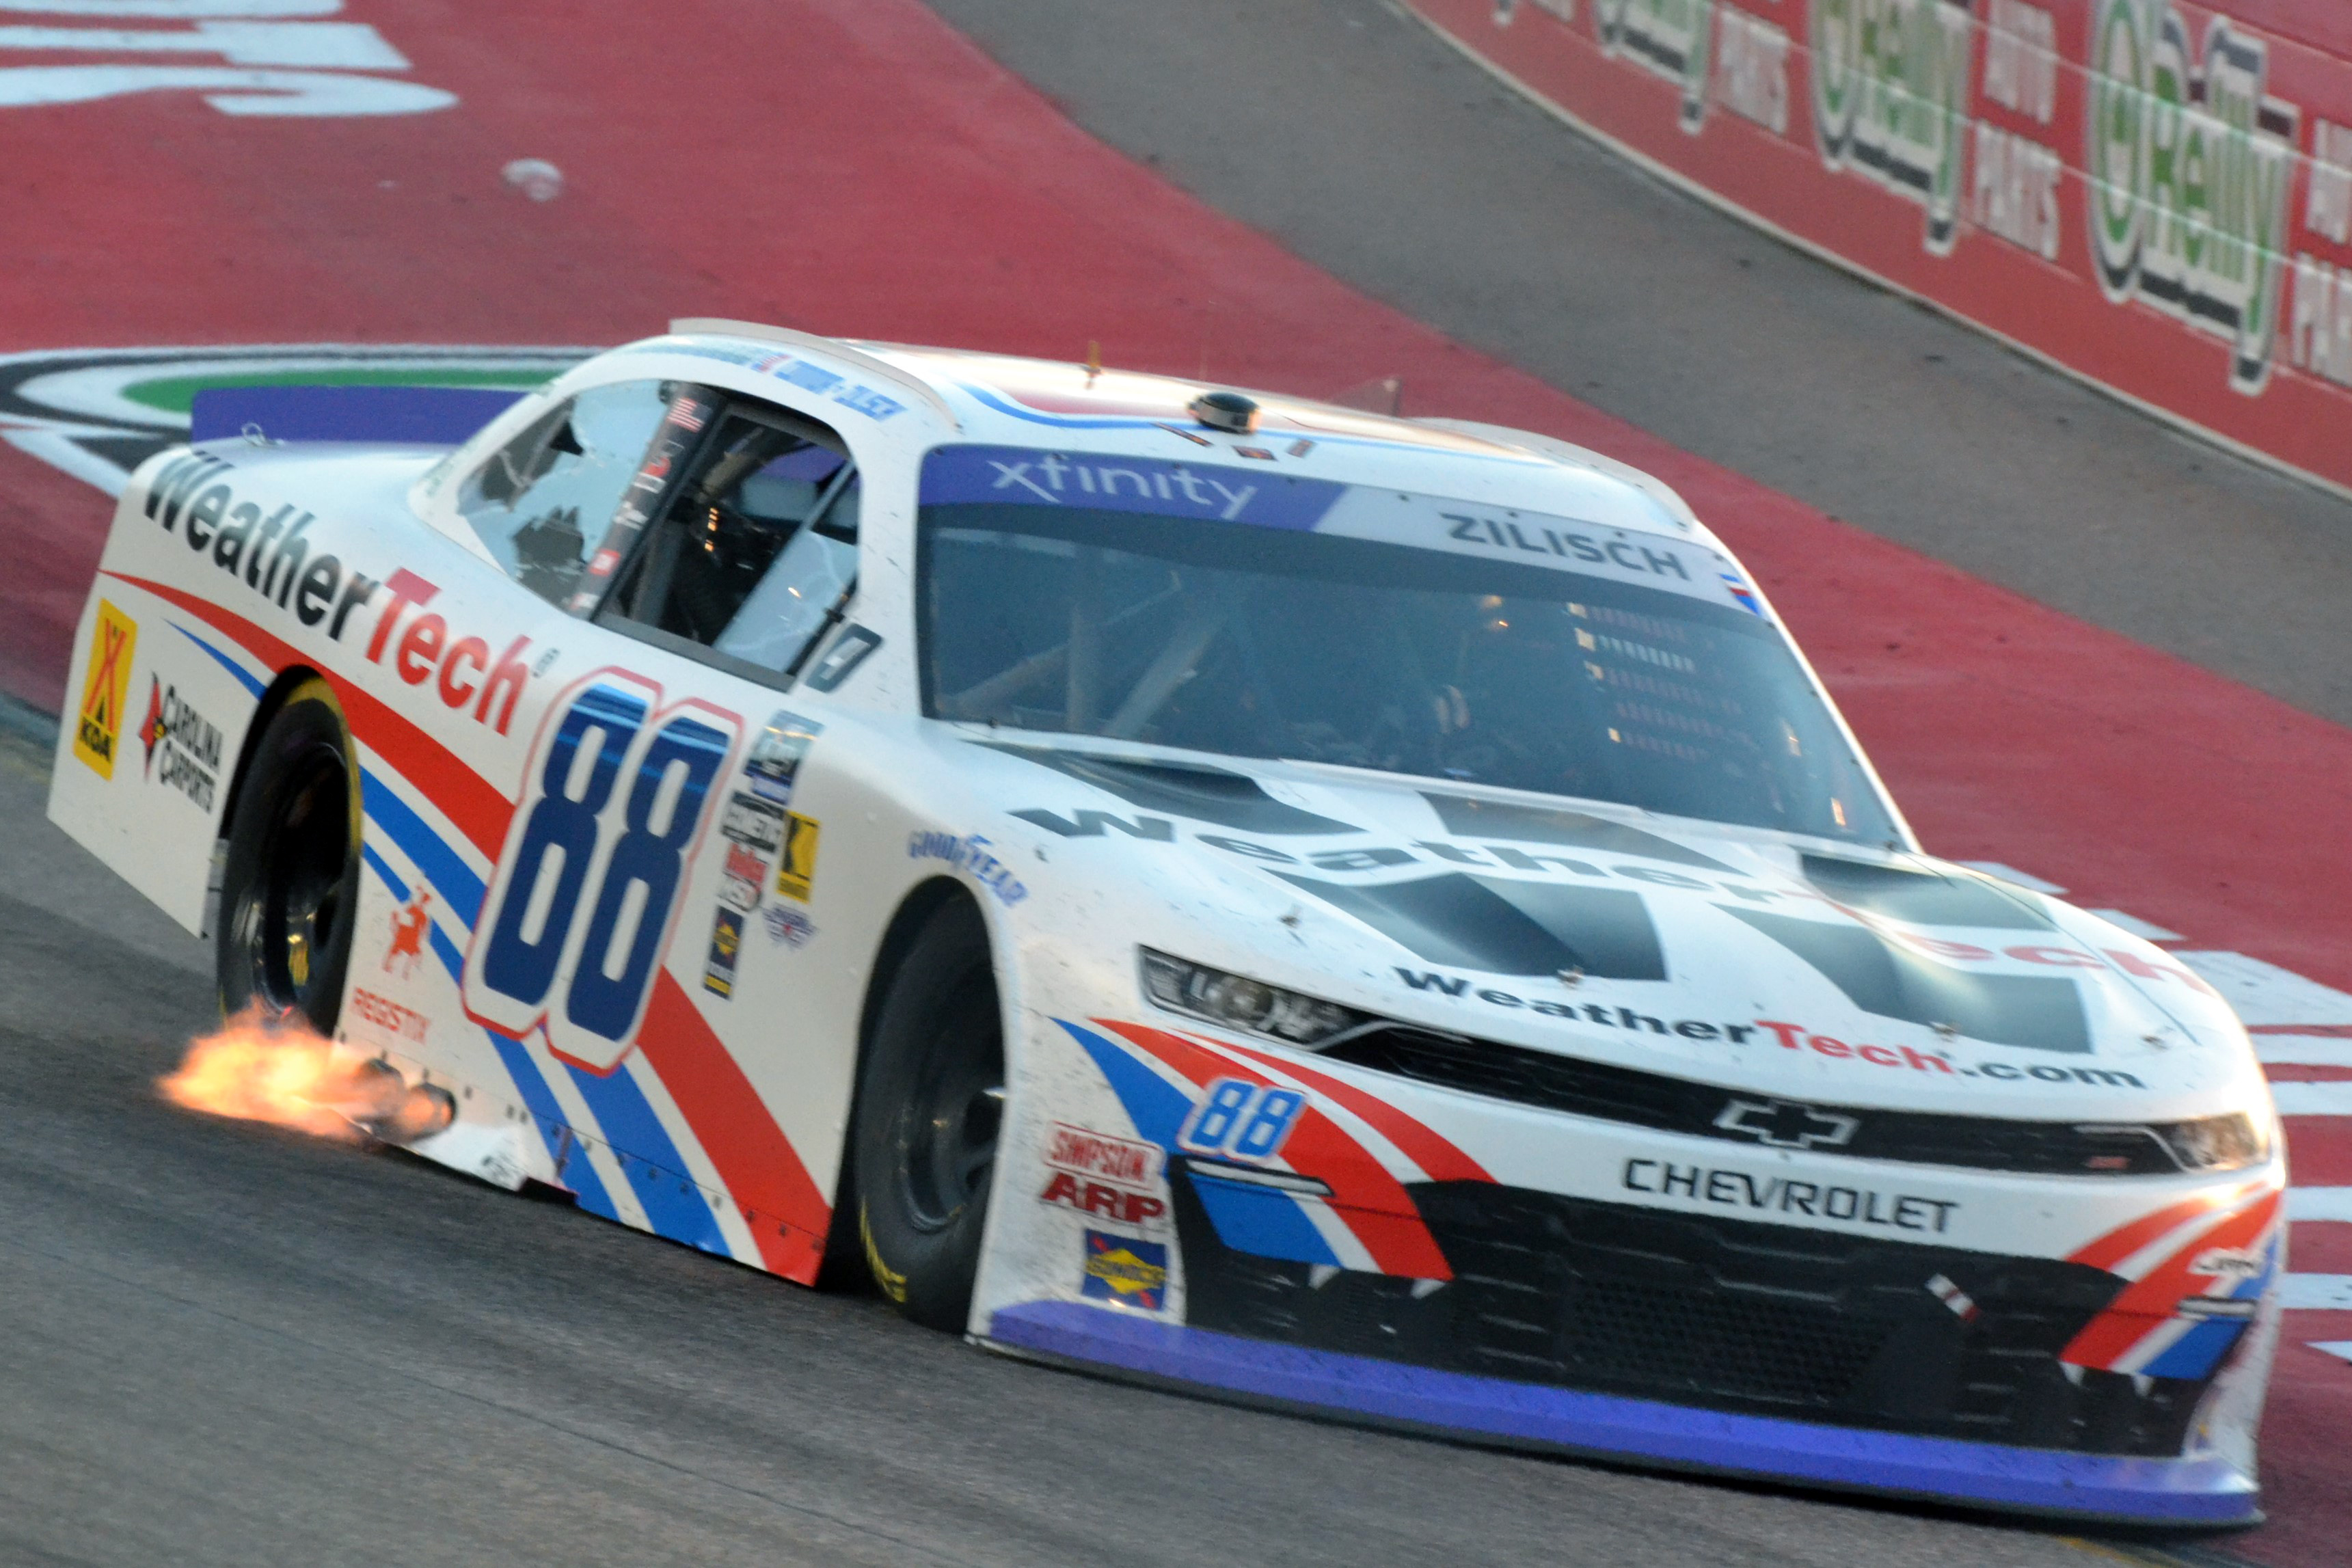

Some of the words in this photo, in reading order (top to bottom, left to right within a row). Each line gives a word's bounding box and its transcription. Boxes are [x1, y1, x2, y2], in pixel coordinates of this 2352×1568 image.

[986, 452, 1258, 521] xfinity
[1438, 511, 1692, 581] ZILISCH
[142, 448, 536, 740] WeatherTech
[79, 715, 113, 765] KOA
[164, 684, 224, 776] CAROLINA
[477, 677, 735, 1049] 88
[1392, 965, 2148, 1090] WeatherTech.com
[1178, 1075, 1307, 1159] 88
[1051, 1129, 1148, 1181] SIMPSON
[1040, 1172, 1166, 1224] ARP
[1623, 1158, 1960, 1232] CHEVROLET
